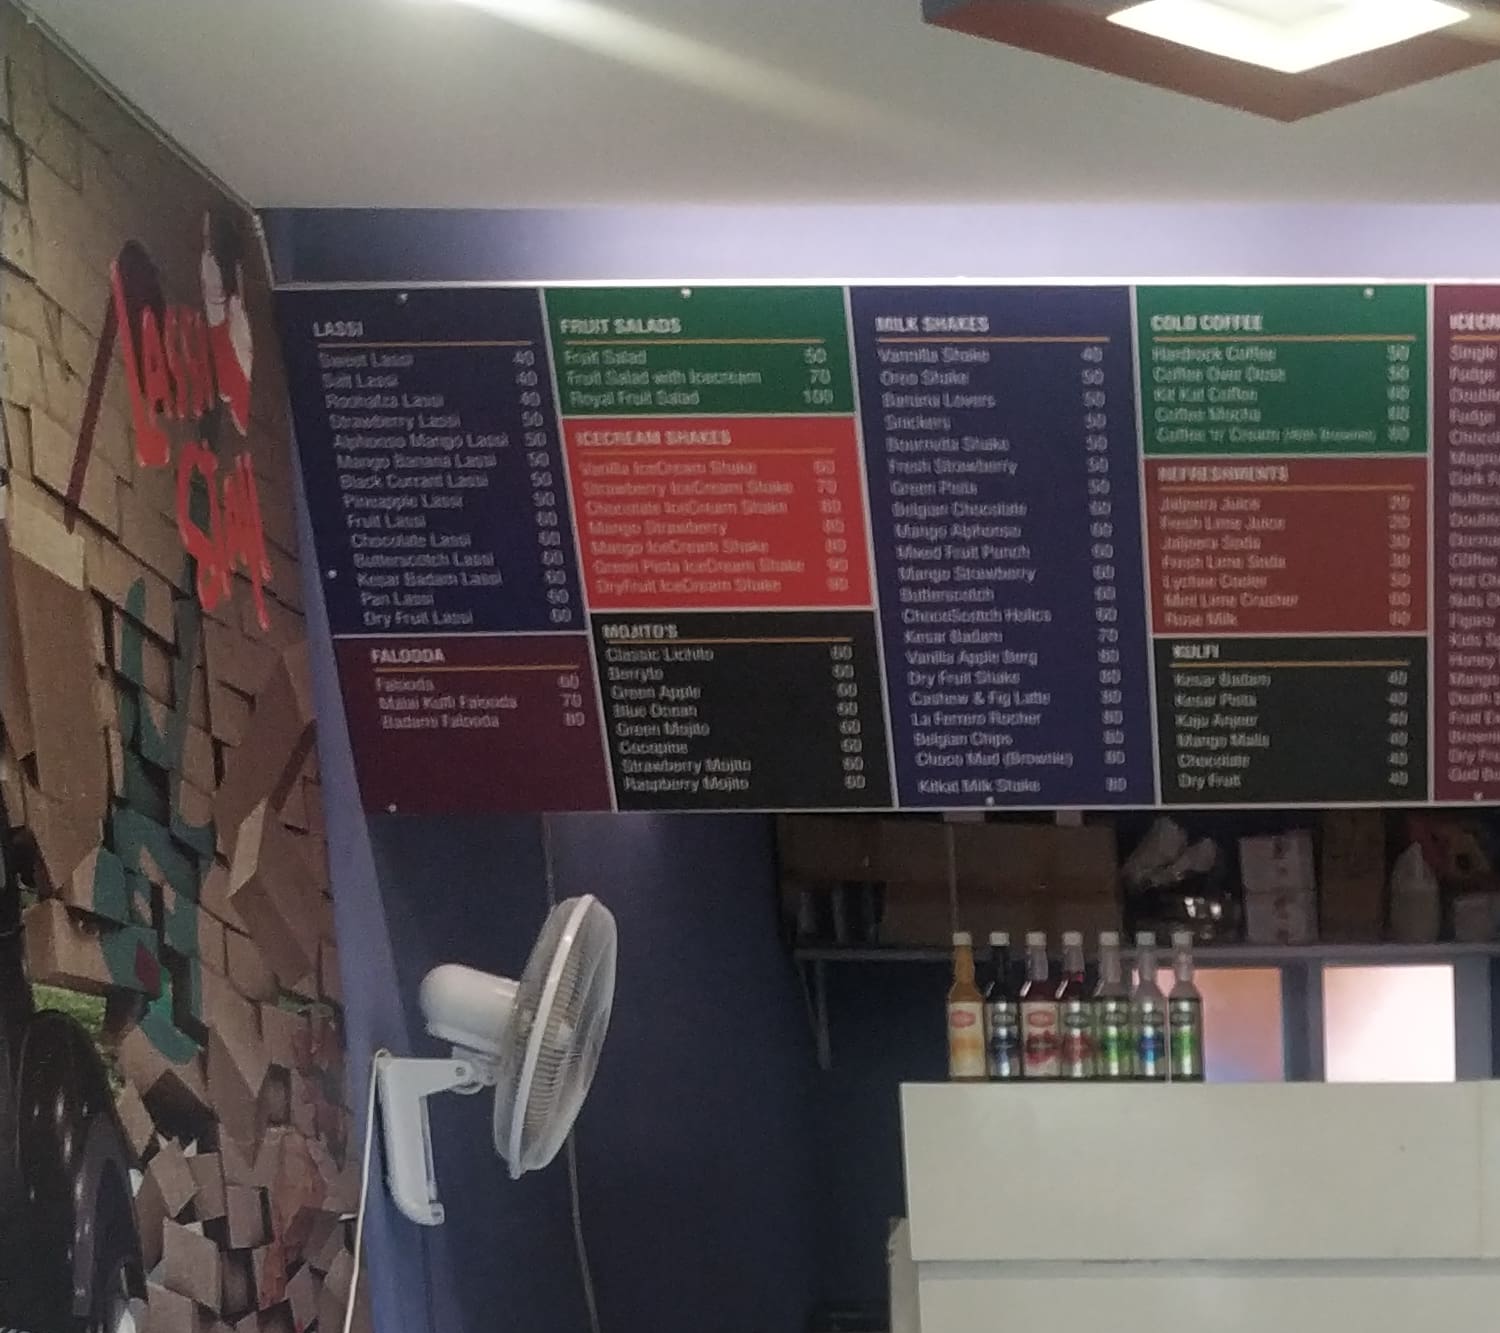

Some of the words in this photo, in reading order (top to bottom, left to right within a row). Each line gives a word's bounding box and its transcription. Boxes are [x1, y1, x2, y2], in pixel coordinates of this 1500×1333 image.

[313, 321, 363, 337] LASSI
[560, 319, 609, 334] FRUIT
[613, 318, 682, 333] SALADS
[876, 317, 918, 332] MILK
[921, 316, 990, 332] SHAKES
[1151, 315, 1197, 331] COLD
[1198, 314, 1262, 331] COFFEE
[369, 352, 414, 368] Lassi
[576, 431, 661, 446] ICECREAM
[664, 430, 731, 445] SHAKES
[371, 649, 445, 663] FALOODA
